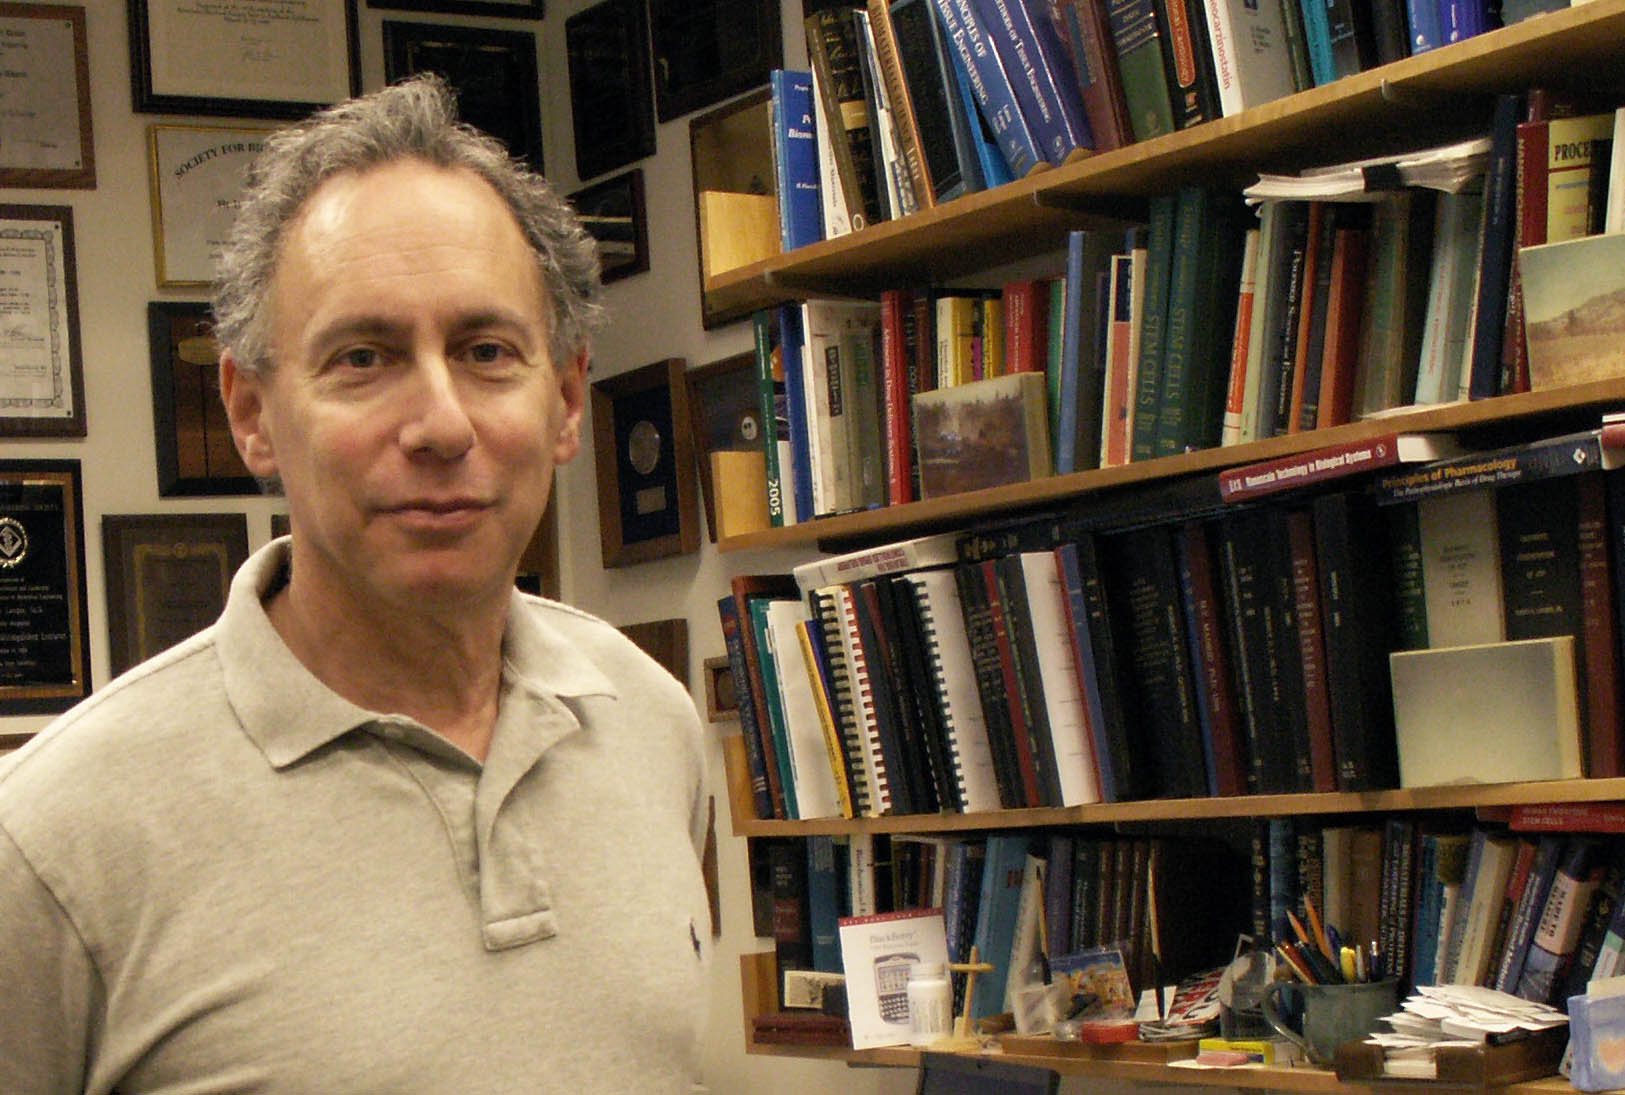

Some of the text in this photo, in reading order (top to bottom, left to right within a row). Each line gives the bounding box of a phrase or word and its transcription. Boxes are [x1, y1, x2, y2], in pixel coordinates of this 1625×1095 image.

[174, 146, 218, 179] SOCIETY
[221, 143, 245, 155] FOR
[1431, 467, 1444, 481] of
[1443, 458, 1519, 479] Pharmacology
[767, 480, 781, 516] 2005
